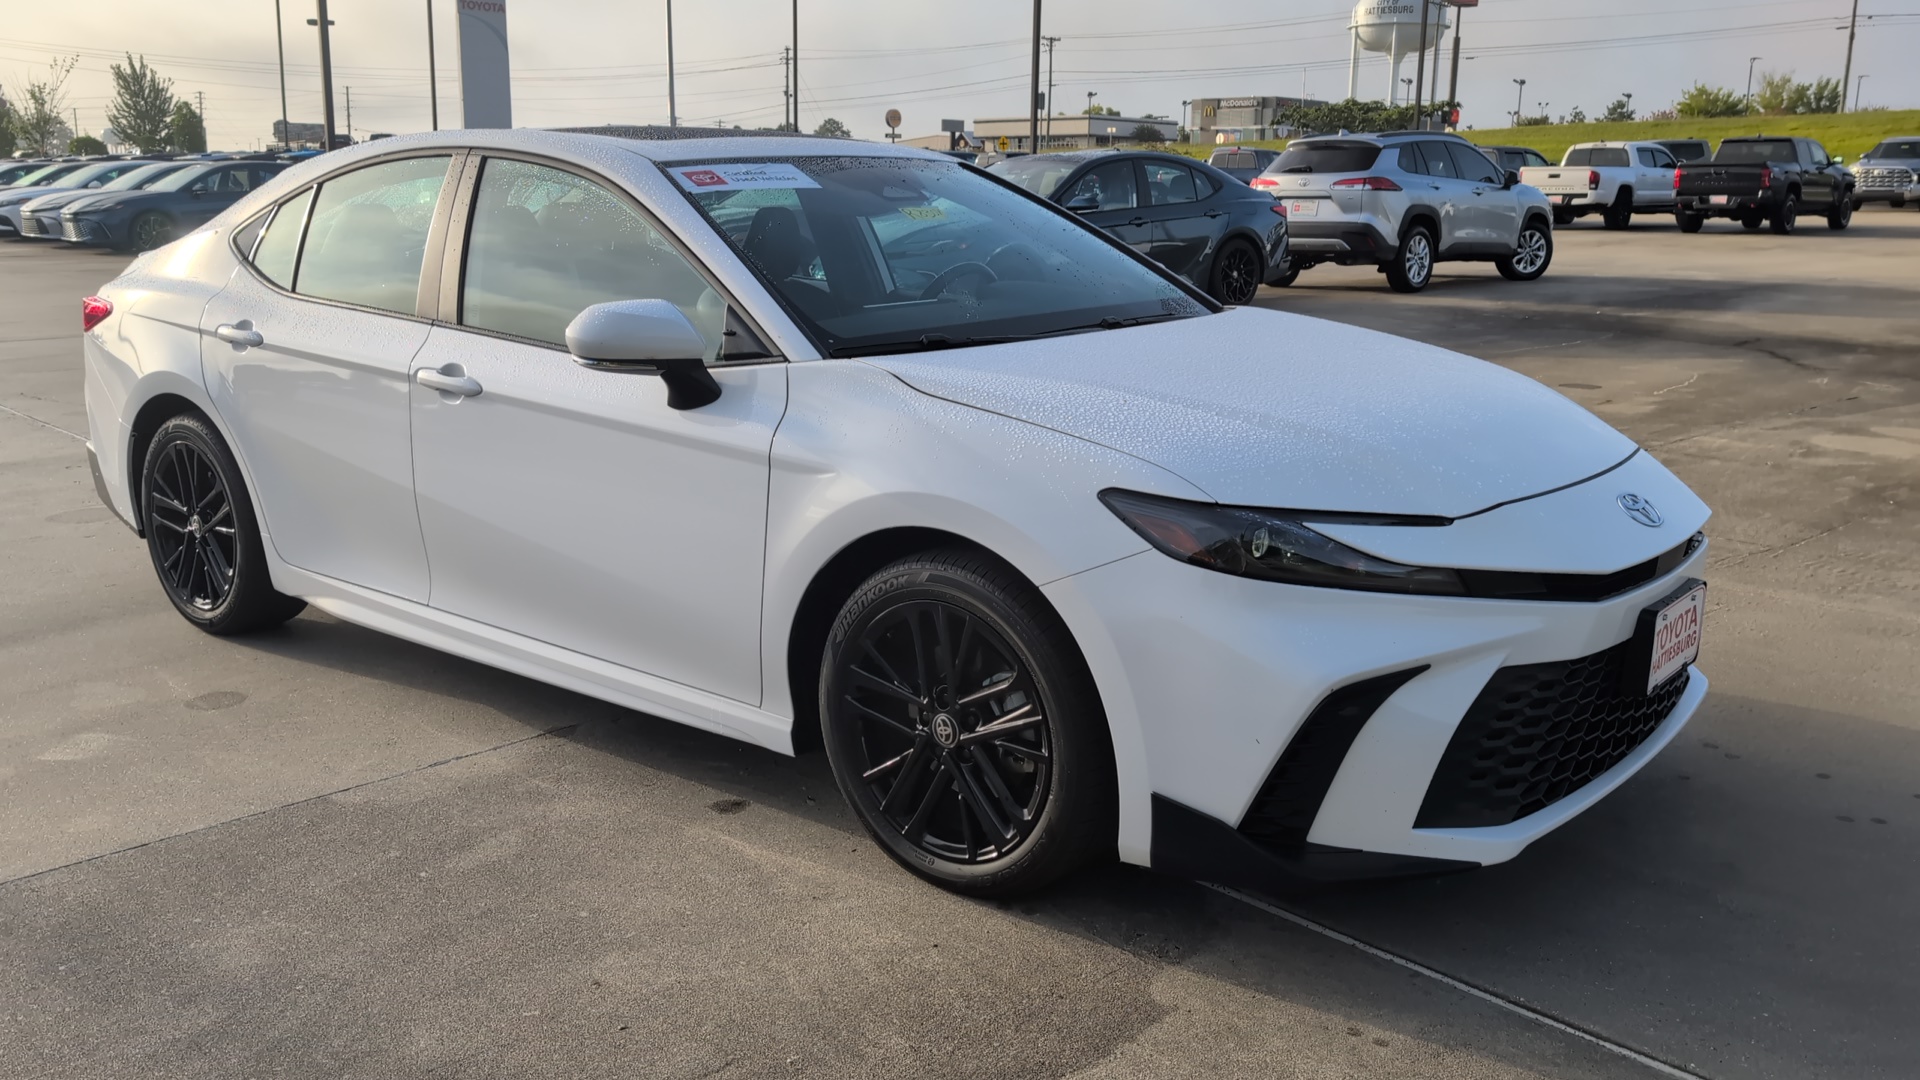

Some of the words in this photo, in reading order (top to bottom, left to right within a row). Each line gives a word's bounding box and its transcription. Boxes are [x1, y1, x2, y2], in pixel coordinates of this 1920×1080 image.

[460, 0, 506, 14] TOYOTA
[1220, 100, 1258, 108] McDonald's
[1656, 605, 1697, 654] TOYOTA
[1652, 630, 1697, 674] HATTIESBURG
